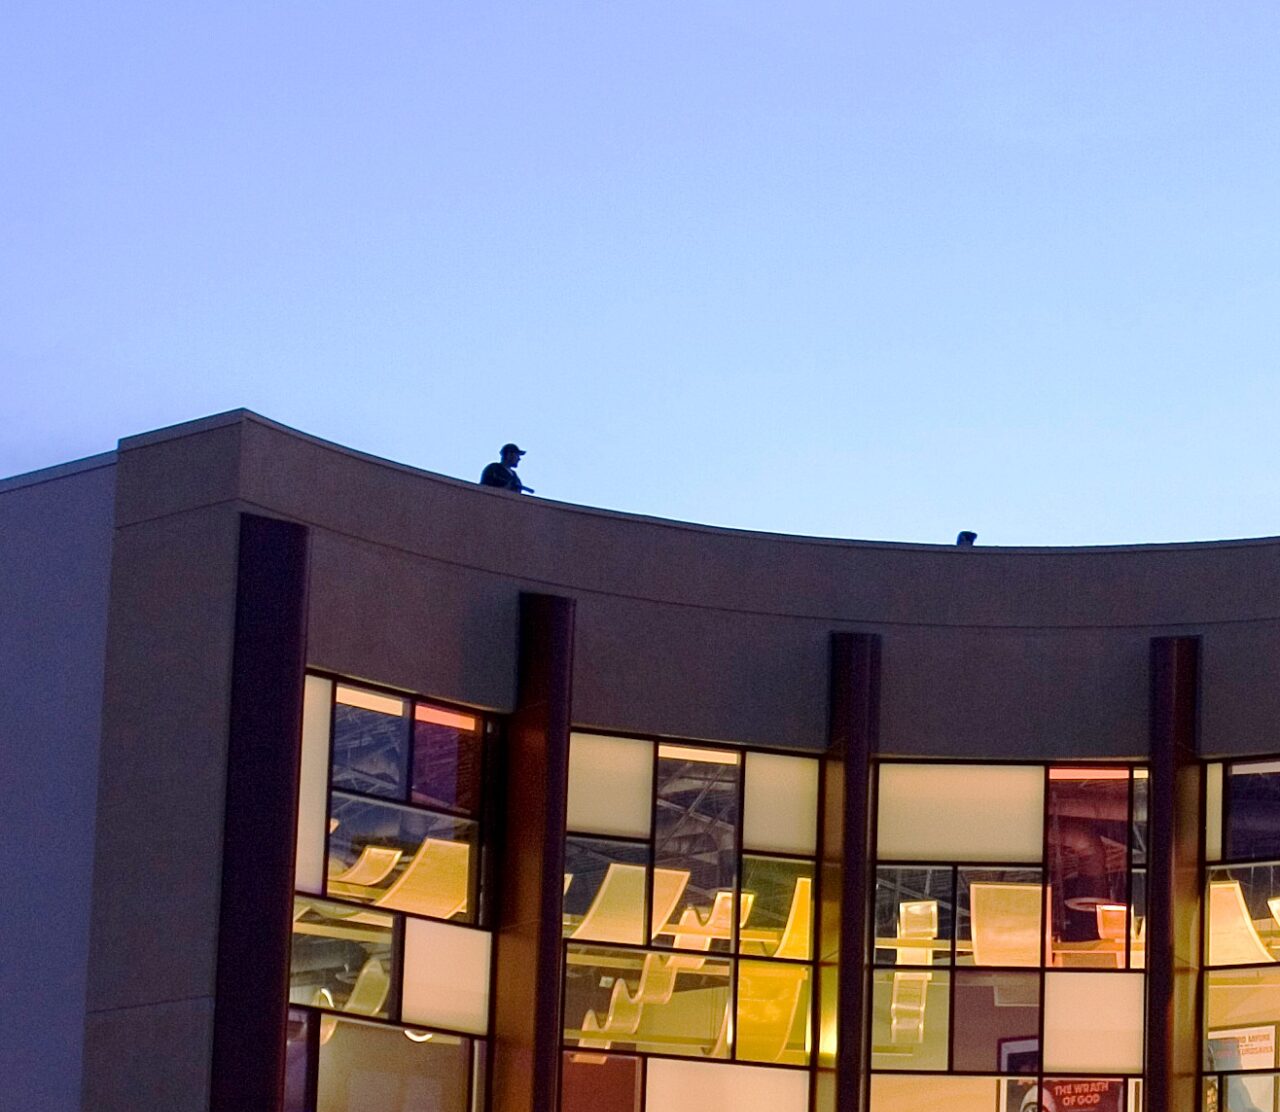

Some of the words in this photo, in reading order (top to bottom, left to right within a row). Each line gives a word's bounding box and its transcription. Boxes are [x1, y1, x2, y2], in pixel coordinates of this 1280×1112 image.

[1054, 1085, 1072, 1096] THE
[1074, 1082, 1109, 1093] WRATH
[1062, 1096, 1074, 1106] OF
[1077, 1093, 1100, 1105] GOD
